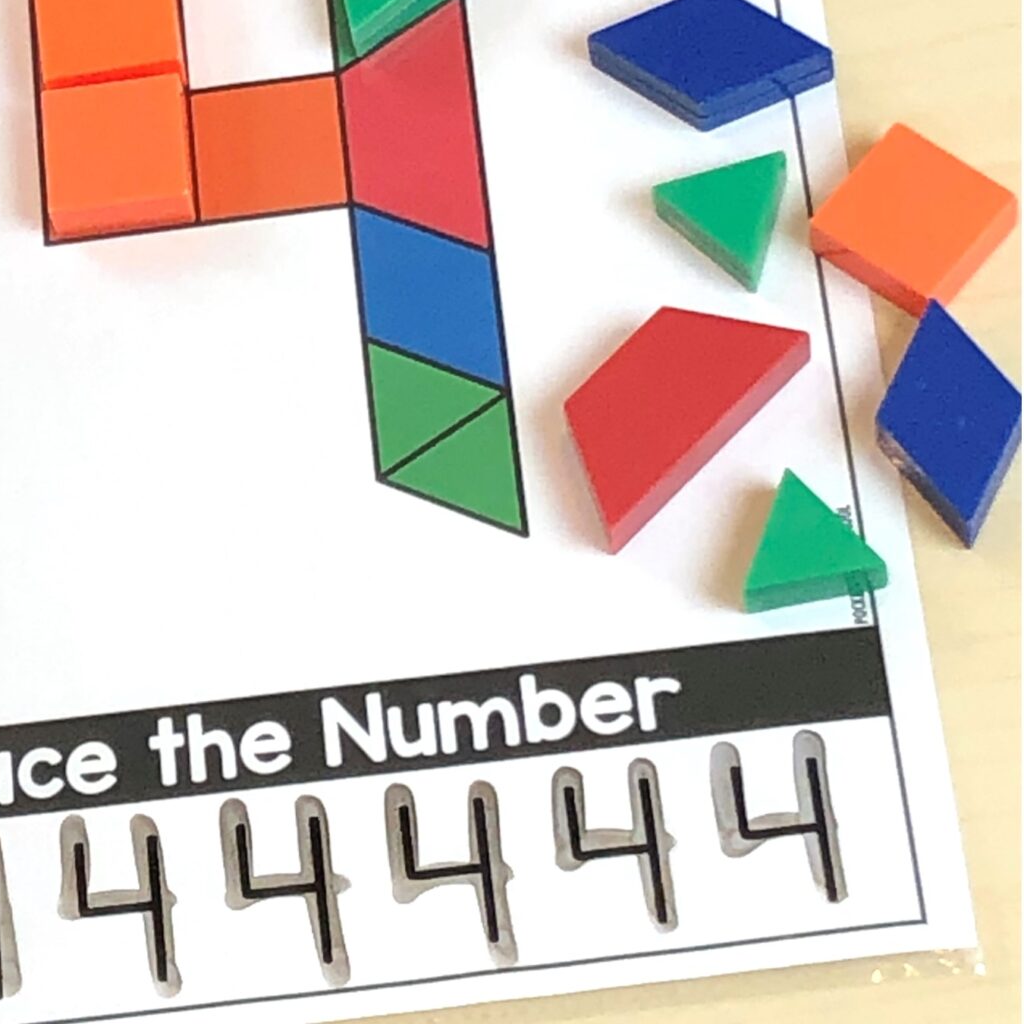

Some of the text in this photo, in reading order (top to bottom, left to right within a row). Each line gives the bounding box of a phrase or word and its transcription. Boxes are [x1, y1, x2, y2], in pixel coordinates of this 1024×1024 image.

[148, 712, 293, 786] the
[319, 673, 682, 768] Number
[58, 814, 183, 998] 4
[219, 794, 352, 988] 4
[384, 779, 519, 967] 4
[552, 757, 680, 933] 4
[710, 729, 849, 904] 4
